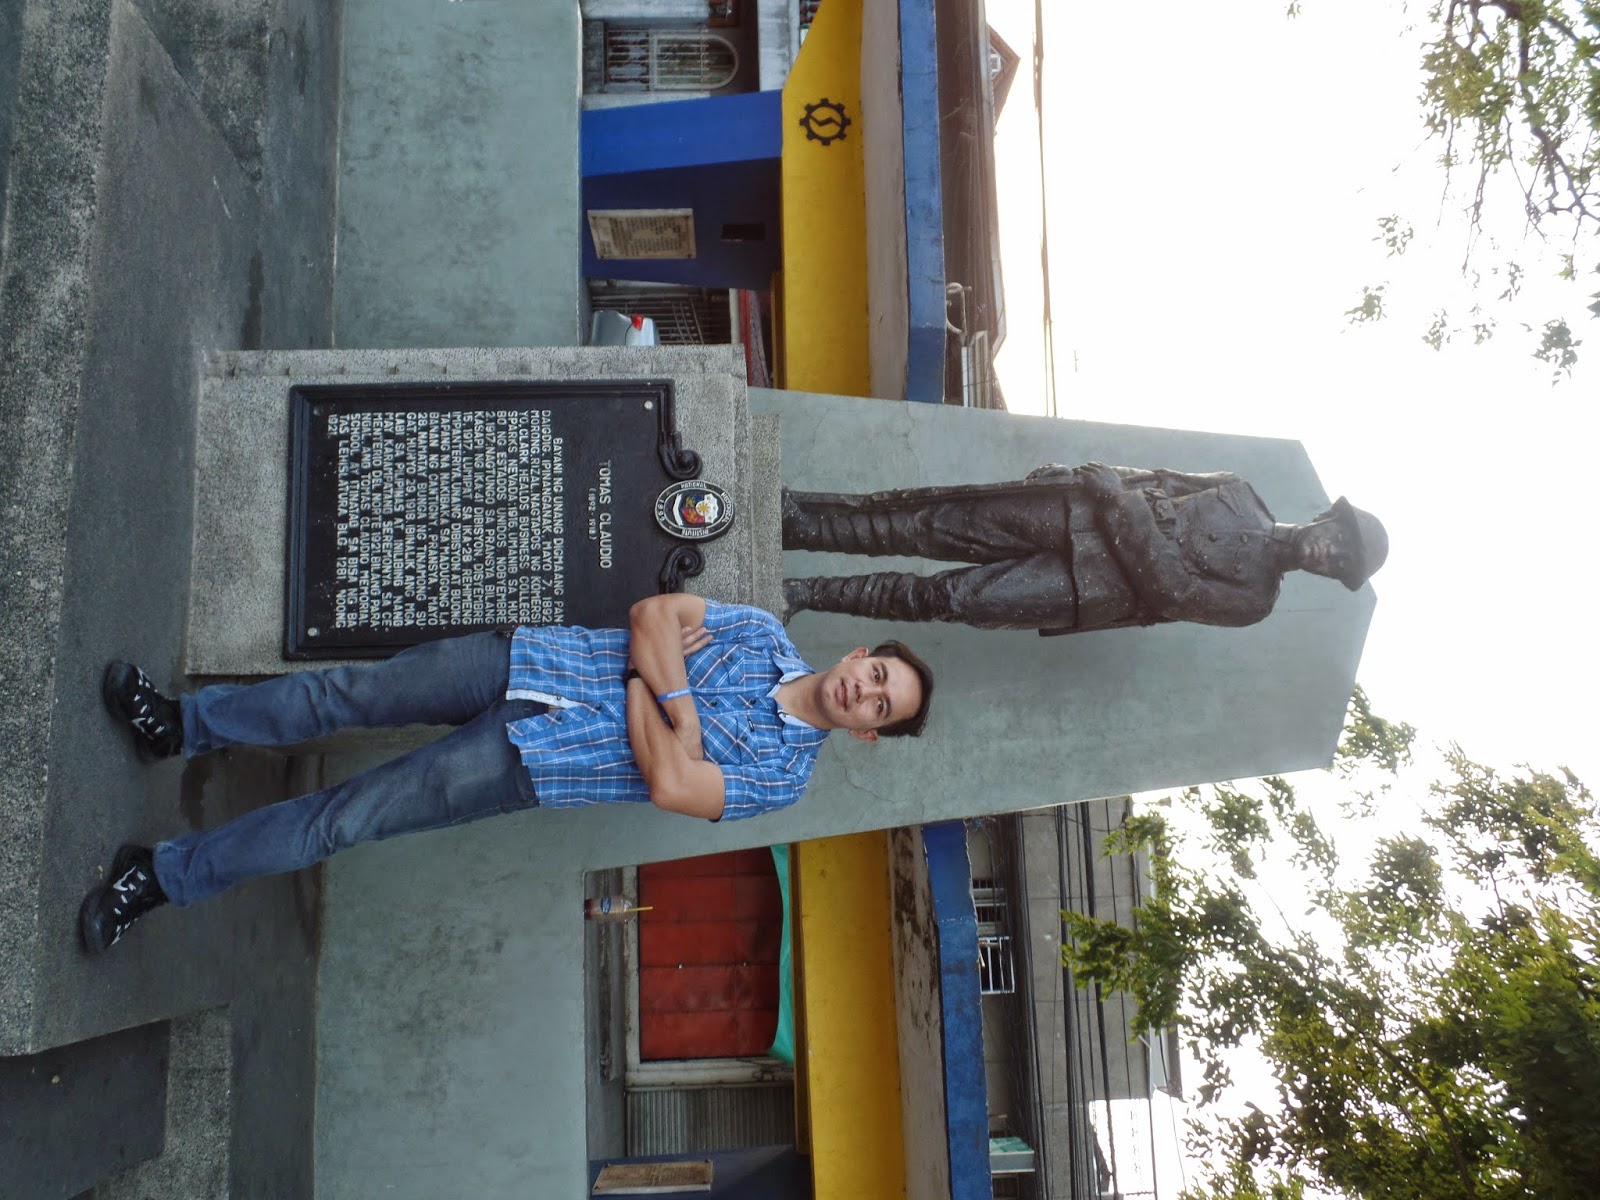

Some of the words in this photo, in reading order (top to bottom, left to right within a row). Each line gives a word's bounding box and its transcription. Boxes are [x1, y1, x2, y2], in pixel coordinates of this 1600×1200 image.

[339, 414, 349, 434] TAS
[350, 413, 360, 456] SCHOOL
[384, 412, 393, 433] MAY
[395, 412, 405, 435] LABI
[429, 412, 438, 446] BANAN
[440, 412, 450, 450] TAPANG
[474, 411, 484, 448] KASAPI
[497, 411, 506, 425] BO
[508, 411, 517, 452] SPARKS
[372, 413, 382, 466] MENTERIO
[395, 443, 404, 457] SA
[417, 432, 427, 477] NAMATAY
[497, 431, 506, 445] NG
[519, 429, 528, 464] CLARK
[361, 446, 370, 468] ANG
[429, 454, 438, 468] NG
[440, 454, 450, 468] NA
[474, 453, 483, 468] NG
[485, 447, 495, 504] NAGTUNGO
[338, 440, 349, 516] LEHISLATURA
[360, 473, 370, 510] TOMAS
[372, 470, 381, 490] DEL
[383, 439, 393, 514] KARAMPATANG
[394, 463, 404, 512] PILIPINAS
[463, 457, 472, 499] LUMIPAT
[474, 472, 483, 502] IKA-41
[497, 452, 506, 500] ESTADOS
[519, 469, 529, 510] HEALDS
[554, 478, 563, 492] NG
[599, 460, 611, 504] TOMAS
[371, 493, 381, 528] NORTE
[417, 483, 427, 519] BUNGA
[440, 473, 450, 525] NAKIBAKA
[451, 482, 461, 518] UNANG
[463, 506, 472, 519] SA
[485, 509, 495, 523] SA
[554, 496, 563, 534] UNANG
[394, 518, 404, 530] AT
[417, 525, 426, 540] NG
[440, 528, 450, 543] SA
[531, 493, 540, 550] NAGTAPOS
[348, 538, 358, 552] SA
[360, 517, 370, 564] CLAUDIO
[382, 521, 392, 586] SEREMONYA
[405, 525, 415, 569] IBINALIK
[451, 523, 461, 570] DIBISYON
[462, 525, 472, 562] IKA-28
[485, 529, 495, 578] PRANSYA
[508, 533, 518, 574] UMANIB
[519, 516, 529, 569] BUSINESS
[542, 542, 551, 570] MAYO
[600, 513, 612, 568] CLAUDIO
[348, 557, 358, 583] BISA
[370, 557, 380, 596] BILANG
[394, 540, 404, 586] INILIBING
[416, 545, 426, 601] TINAMONG
[440, 546, 449, 607] MADUGONG
[451, 574, 461, 585] AT
[531, 556, 540, 571] NG
[554, 538, 563, 595] DIGMAANG
[348, 588, 358, 604] NG
[359, 570, 369, 626] MEMORIAL
[382, 592, 392, 606] SA
[405, 575, 415, 597] ANG
[462, 569, 472, 625] REHIMENG
[473, 564, 483, 624] DISYEMBRE
[485, 584, 494, 624] BILANG
[497, 557, 506, 624] NOBYEMBRE
[508, 579, 518, 594] SA
[519, 576, 529, 623] COLLEGE
[336, 590, 346, 628] NOONG
[393, 596, 403, 627] NANG
[405, 603, 415, 626] MGA
[428, 596, 438, 625] MAYO
[451, 589, 461, 625] BUONG
